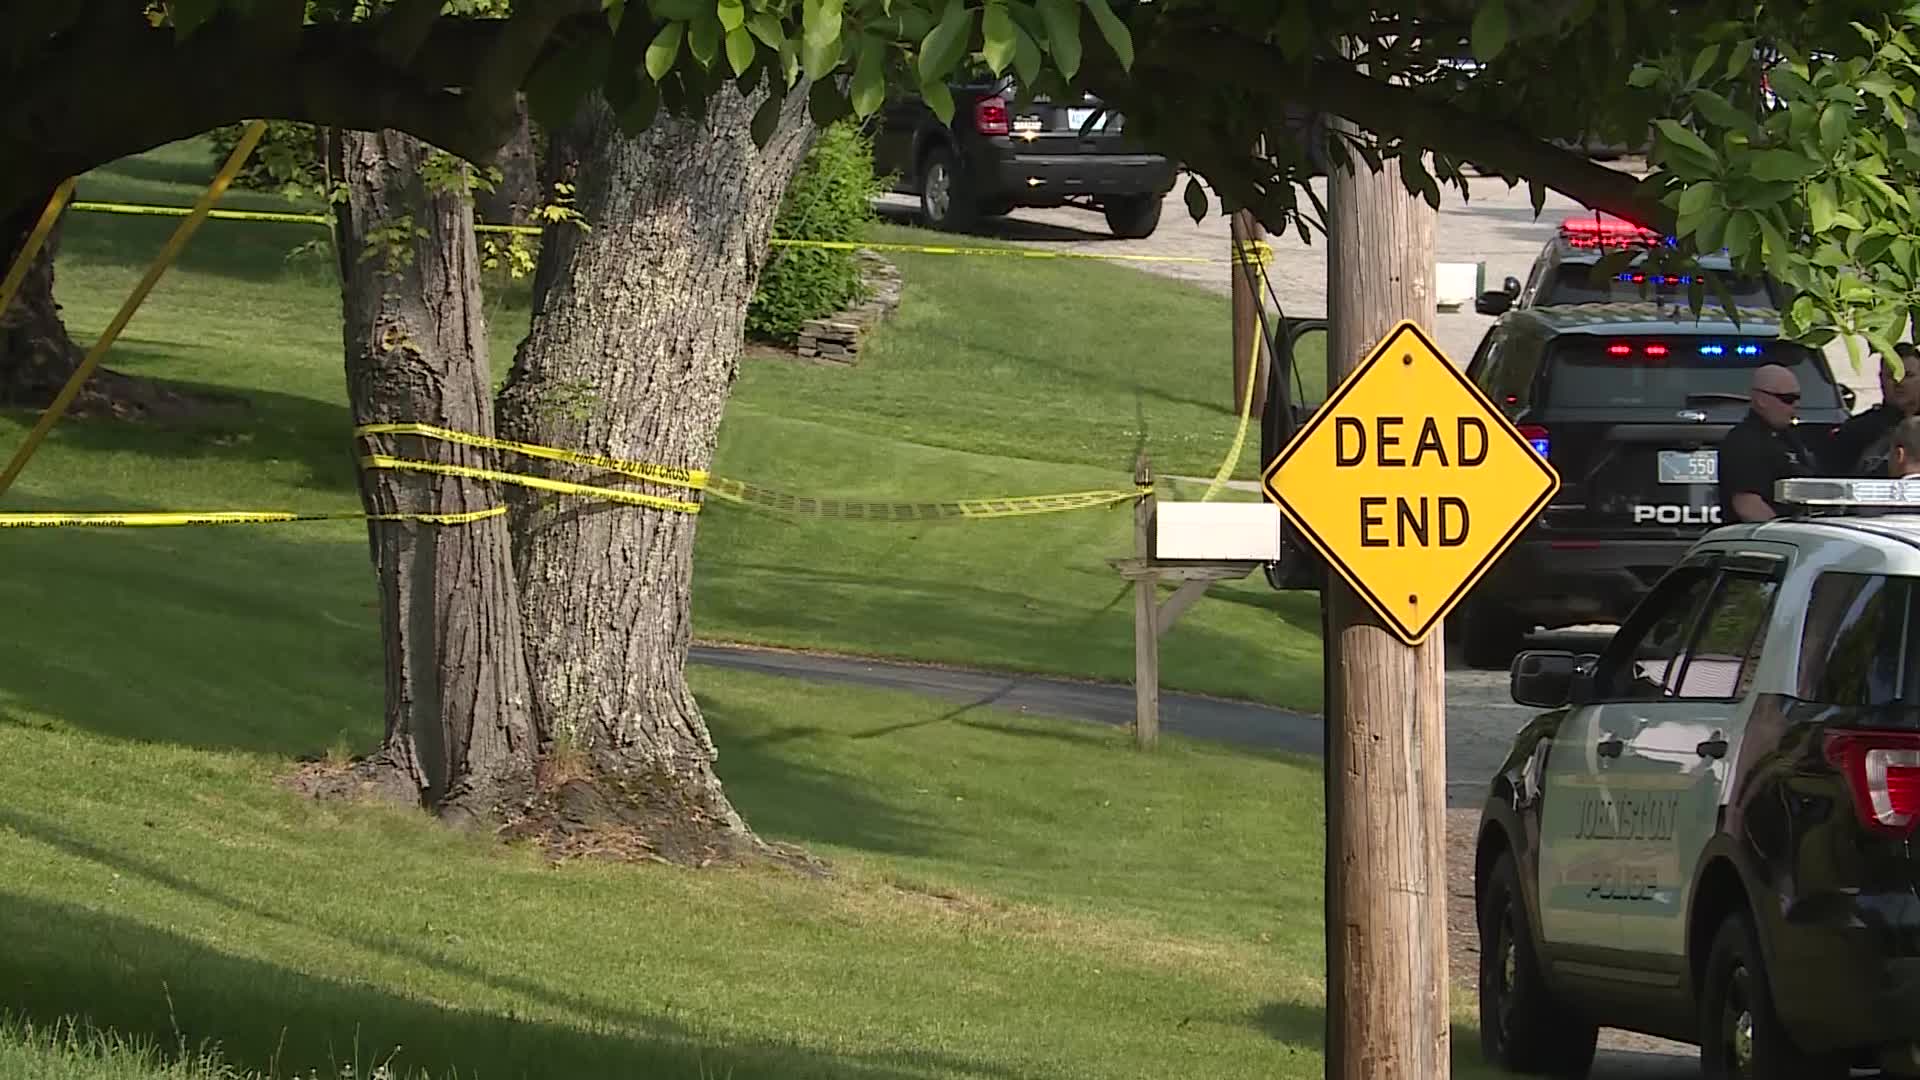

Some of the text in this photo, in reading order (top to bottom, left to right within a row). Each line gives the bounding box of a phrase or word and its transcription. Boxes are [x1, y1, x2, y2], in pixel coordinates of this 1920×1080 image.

[1335, 417, 1489, 467] DEAD
[574, 453, 690, 482] FIRE LINE DO NOT CROSS
[1688, 458, 1715, 475] 550
[1360, 497, 1470, 547] END
[1633, 505, 1723, 524] POLIC
